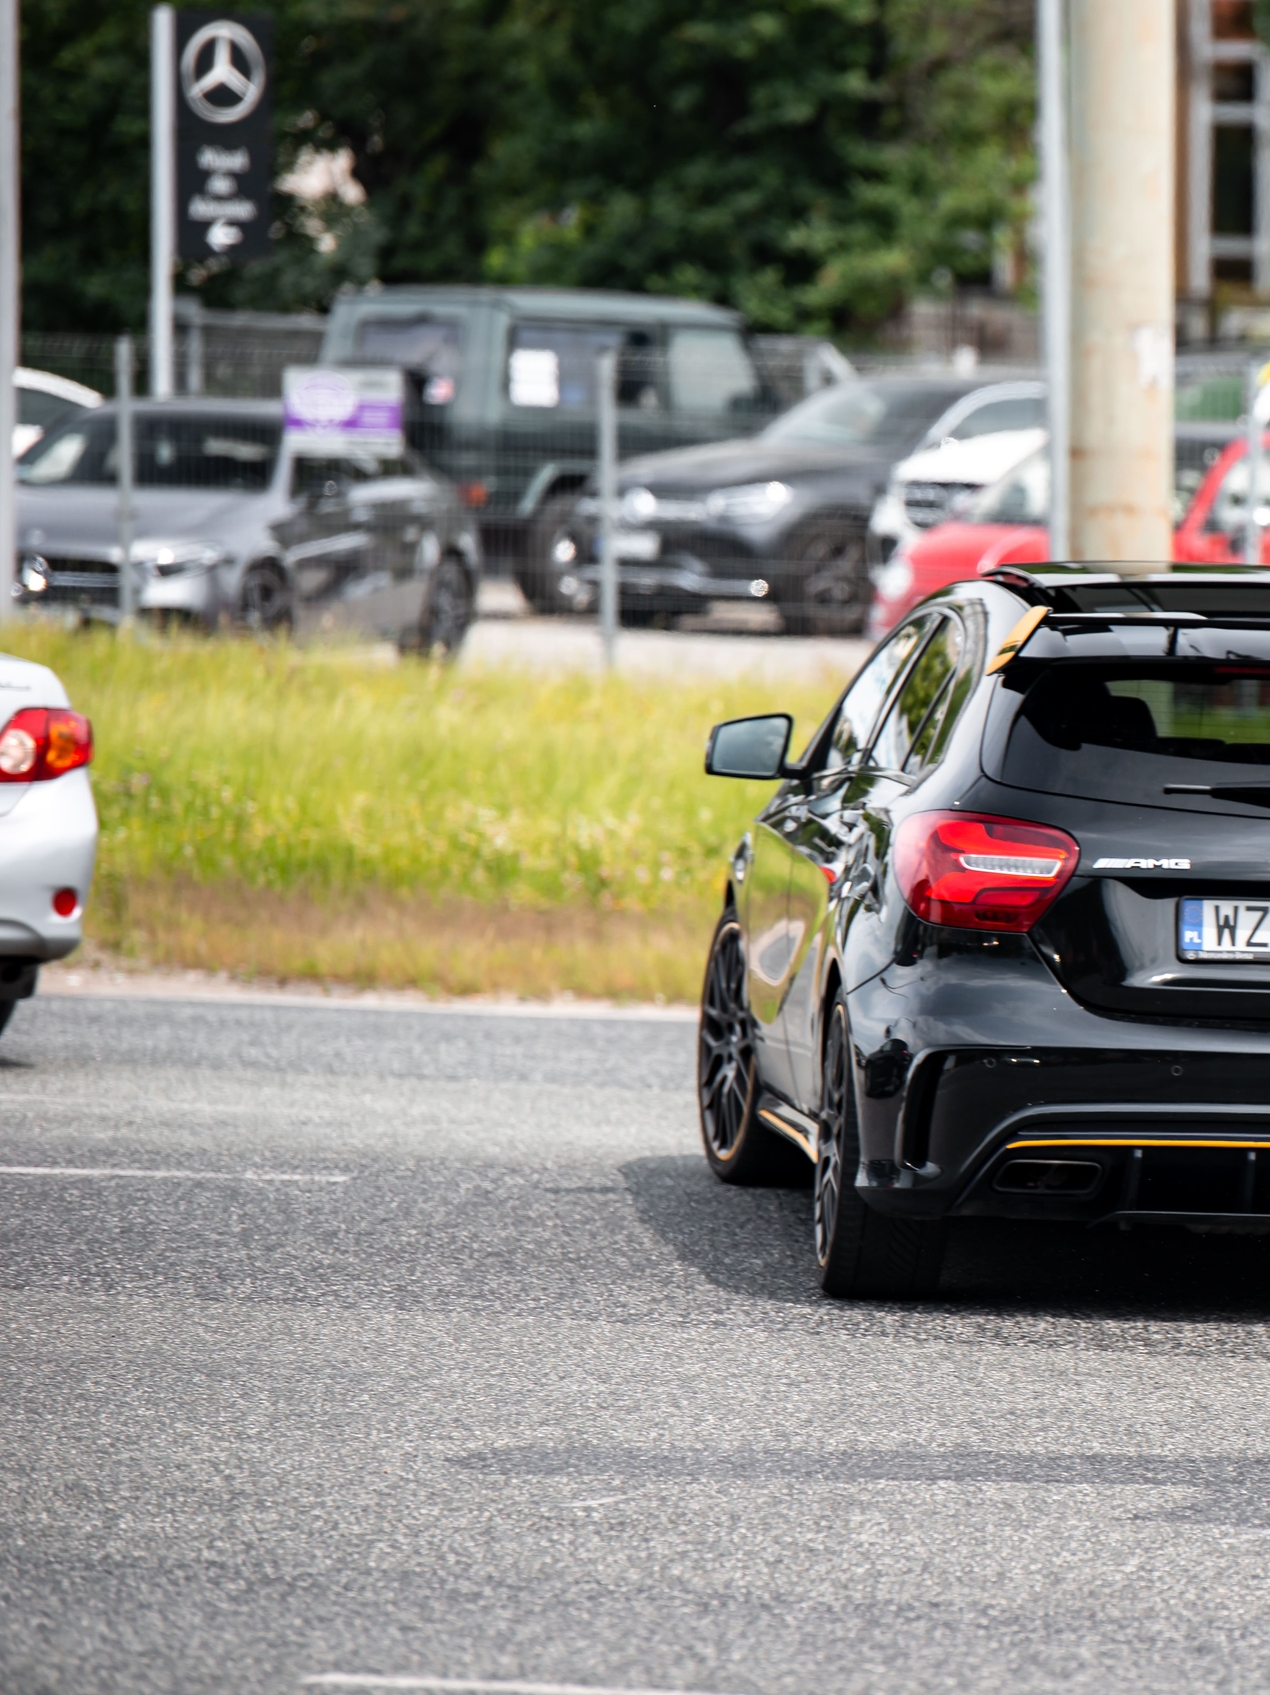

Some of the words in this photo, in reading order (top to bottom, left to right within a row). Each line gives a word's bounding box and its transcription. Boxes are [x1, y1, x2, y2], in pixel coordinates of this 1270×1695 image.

[1125, 858, 1190, 870] AMG
[1214, 905, 1270, 948] WZ
[1184, 930, 1203, 943] PL
